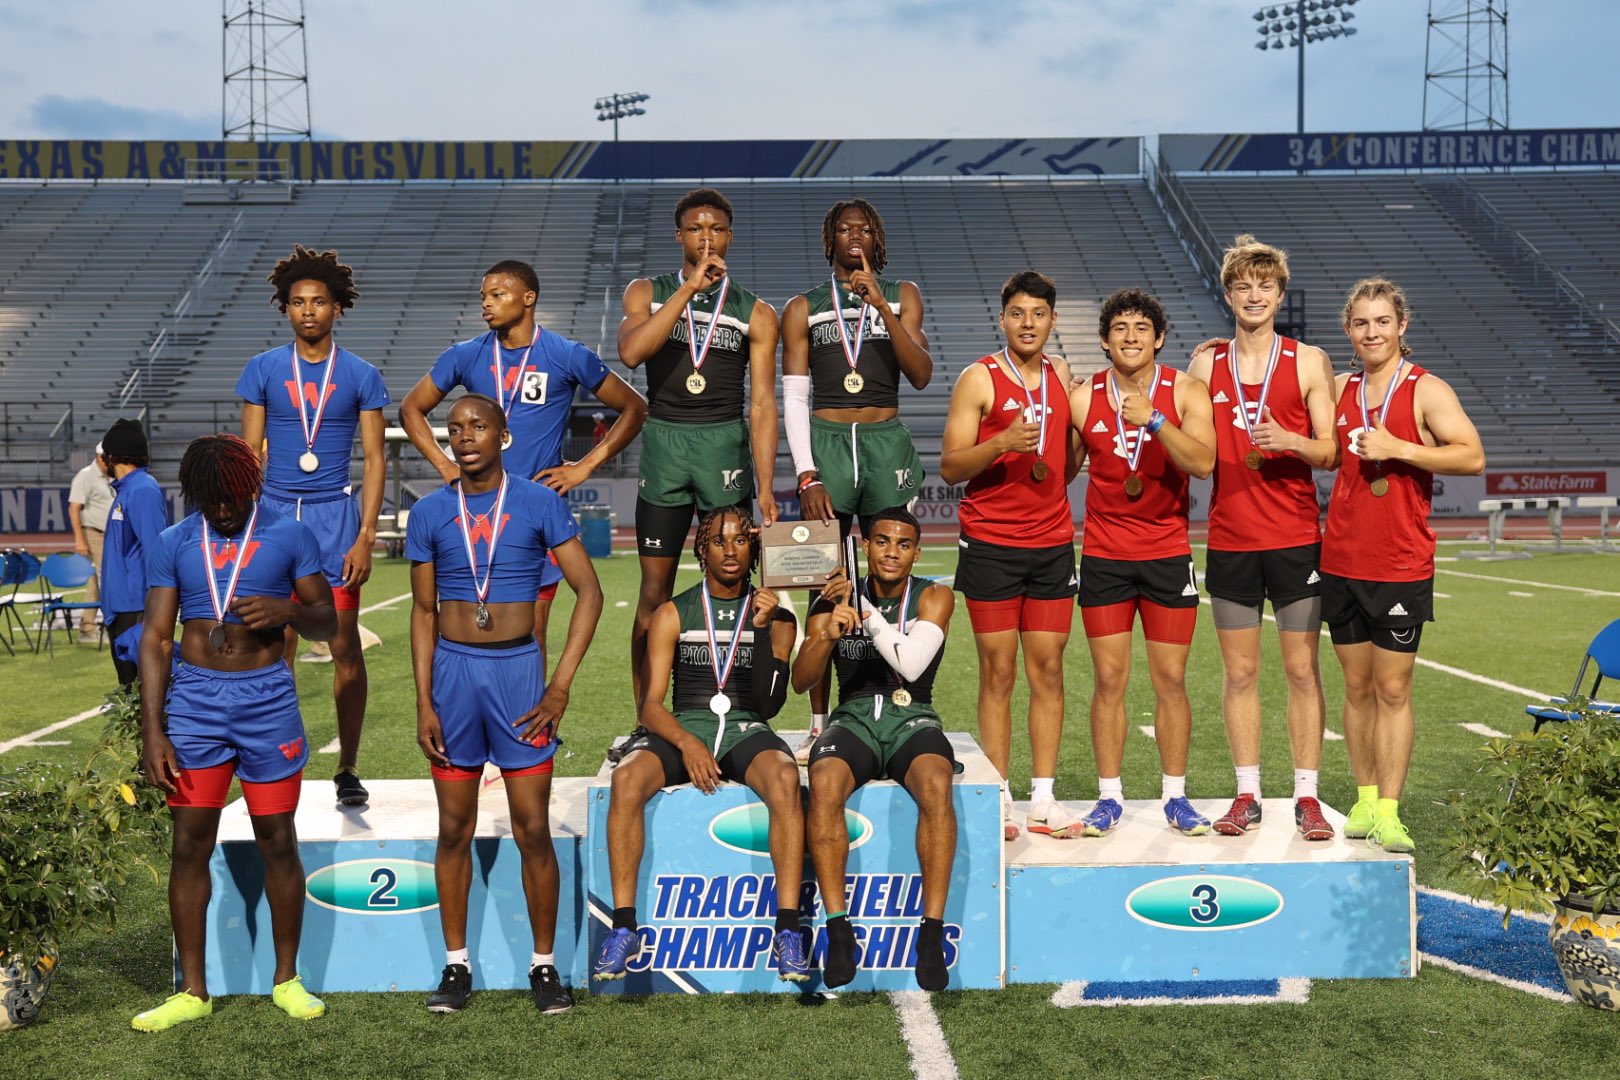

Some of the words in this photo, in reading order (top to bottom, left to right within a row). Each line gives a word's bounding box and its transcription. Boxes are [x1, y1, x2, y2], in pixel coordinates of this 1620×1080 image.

[1288, 137, 1324, 167] 34
[1346, 132, 1532, 167] CONFERENCE
[1541, 132, 1620, 163] CHAM
[284, 380, 337, 410] W
[524, 373, 543, 401] 3
[937, 486, 966, 500] SHA
[912, 503, 954, 519] OYO
[455, 513, 510, 545] W
[200, 541, 261, 570] W
[679, 645, 754, 668] PIOE
[367, 866, 399, 907] 2
[653, 874, 778, 920] TRACK
[1189, 882, 1221, 924] 3
[625, 923, 963, 972] CHAMPNSHIS
